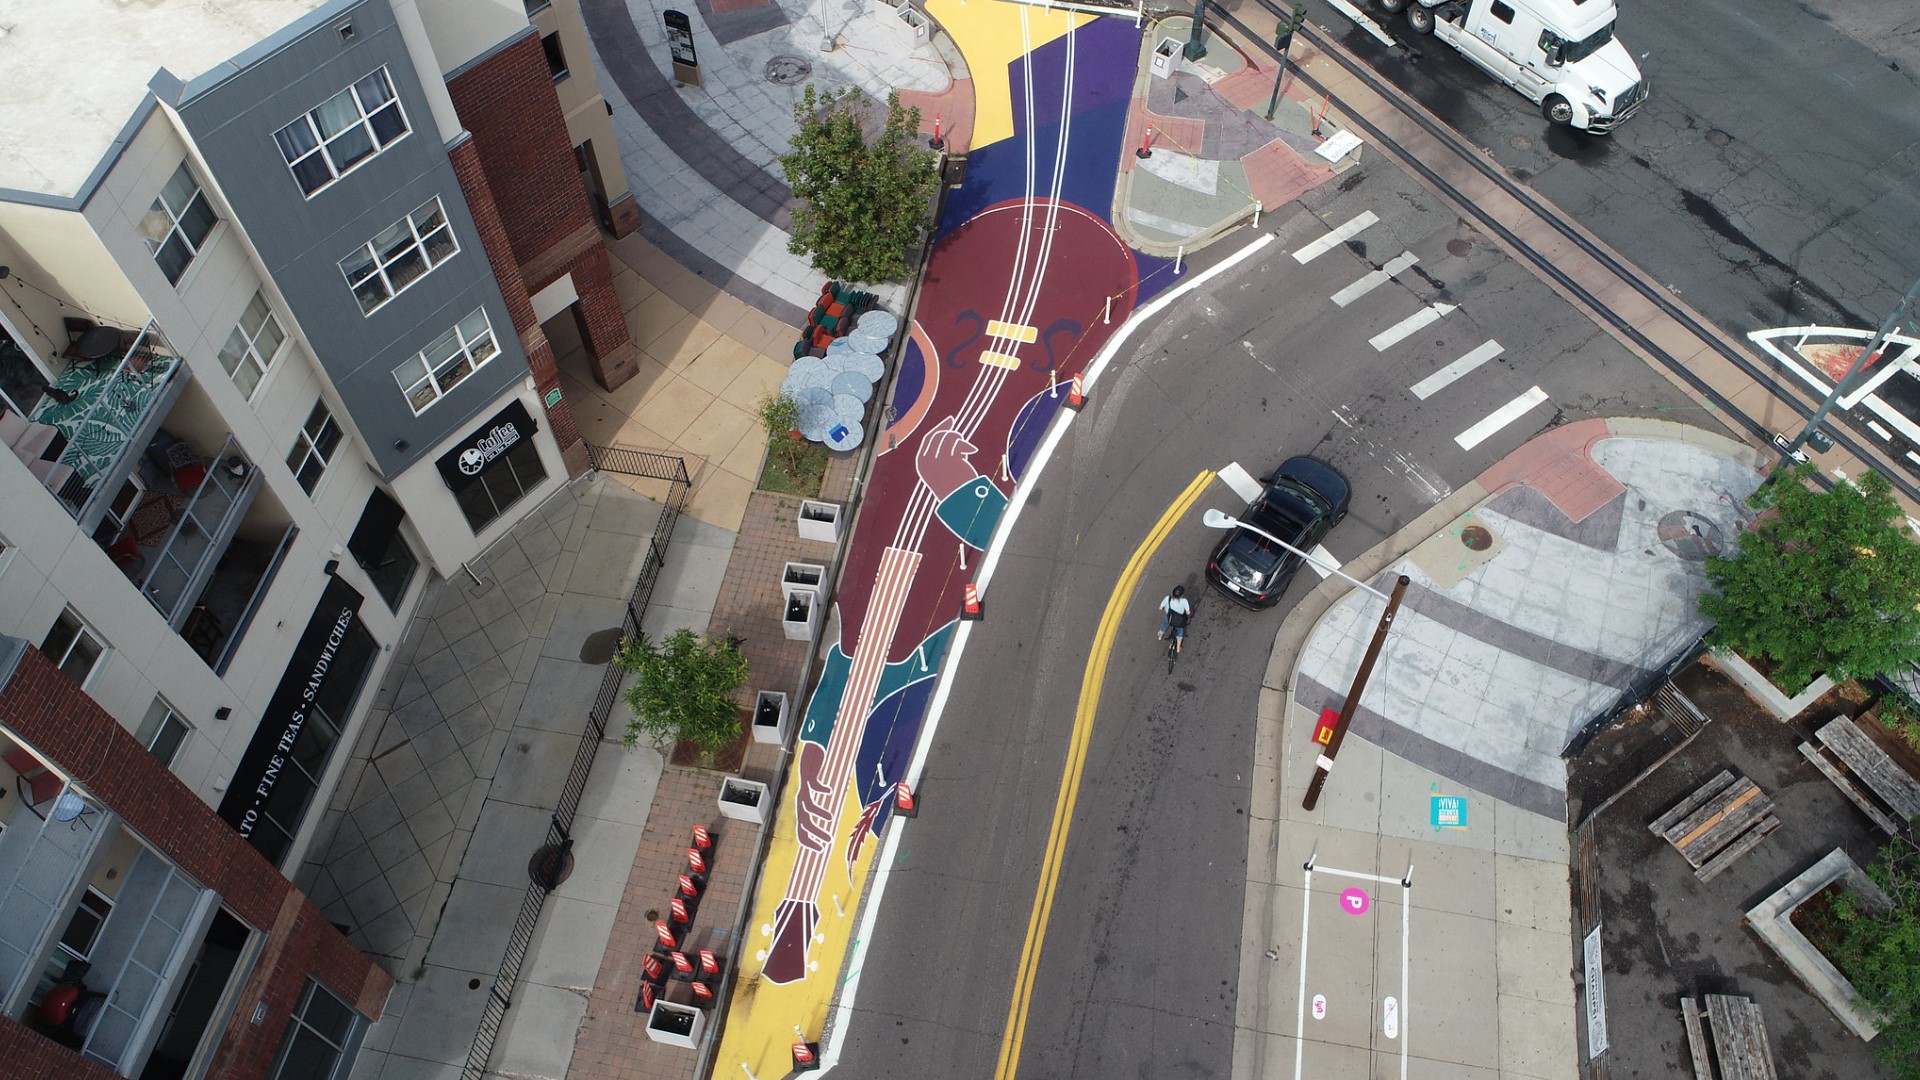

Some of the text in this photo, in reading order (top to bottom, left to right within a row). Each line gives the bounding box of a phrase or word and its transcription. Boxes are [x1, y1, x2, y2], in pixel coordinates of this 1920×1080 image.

[477, 422, 515, 453] Coffee
[256, 754, 284, 799] FINE
[278, 711, 304, 756] TEAS
[303, 606, 352, 702] SANDWICHES
[1346, 895, 1363, 909] P
